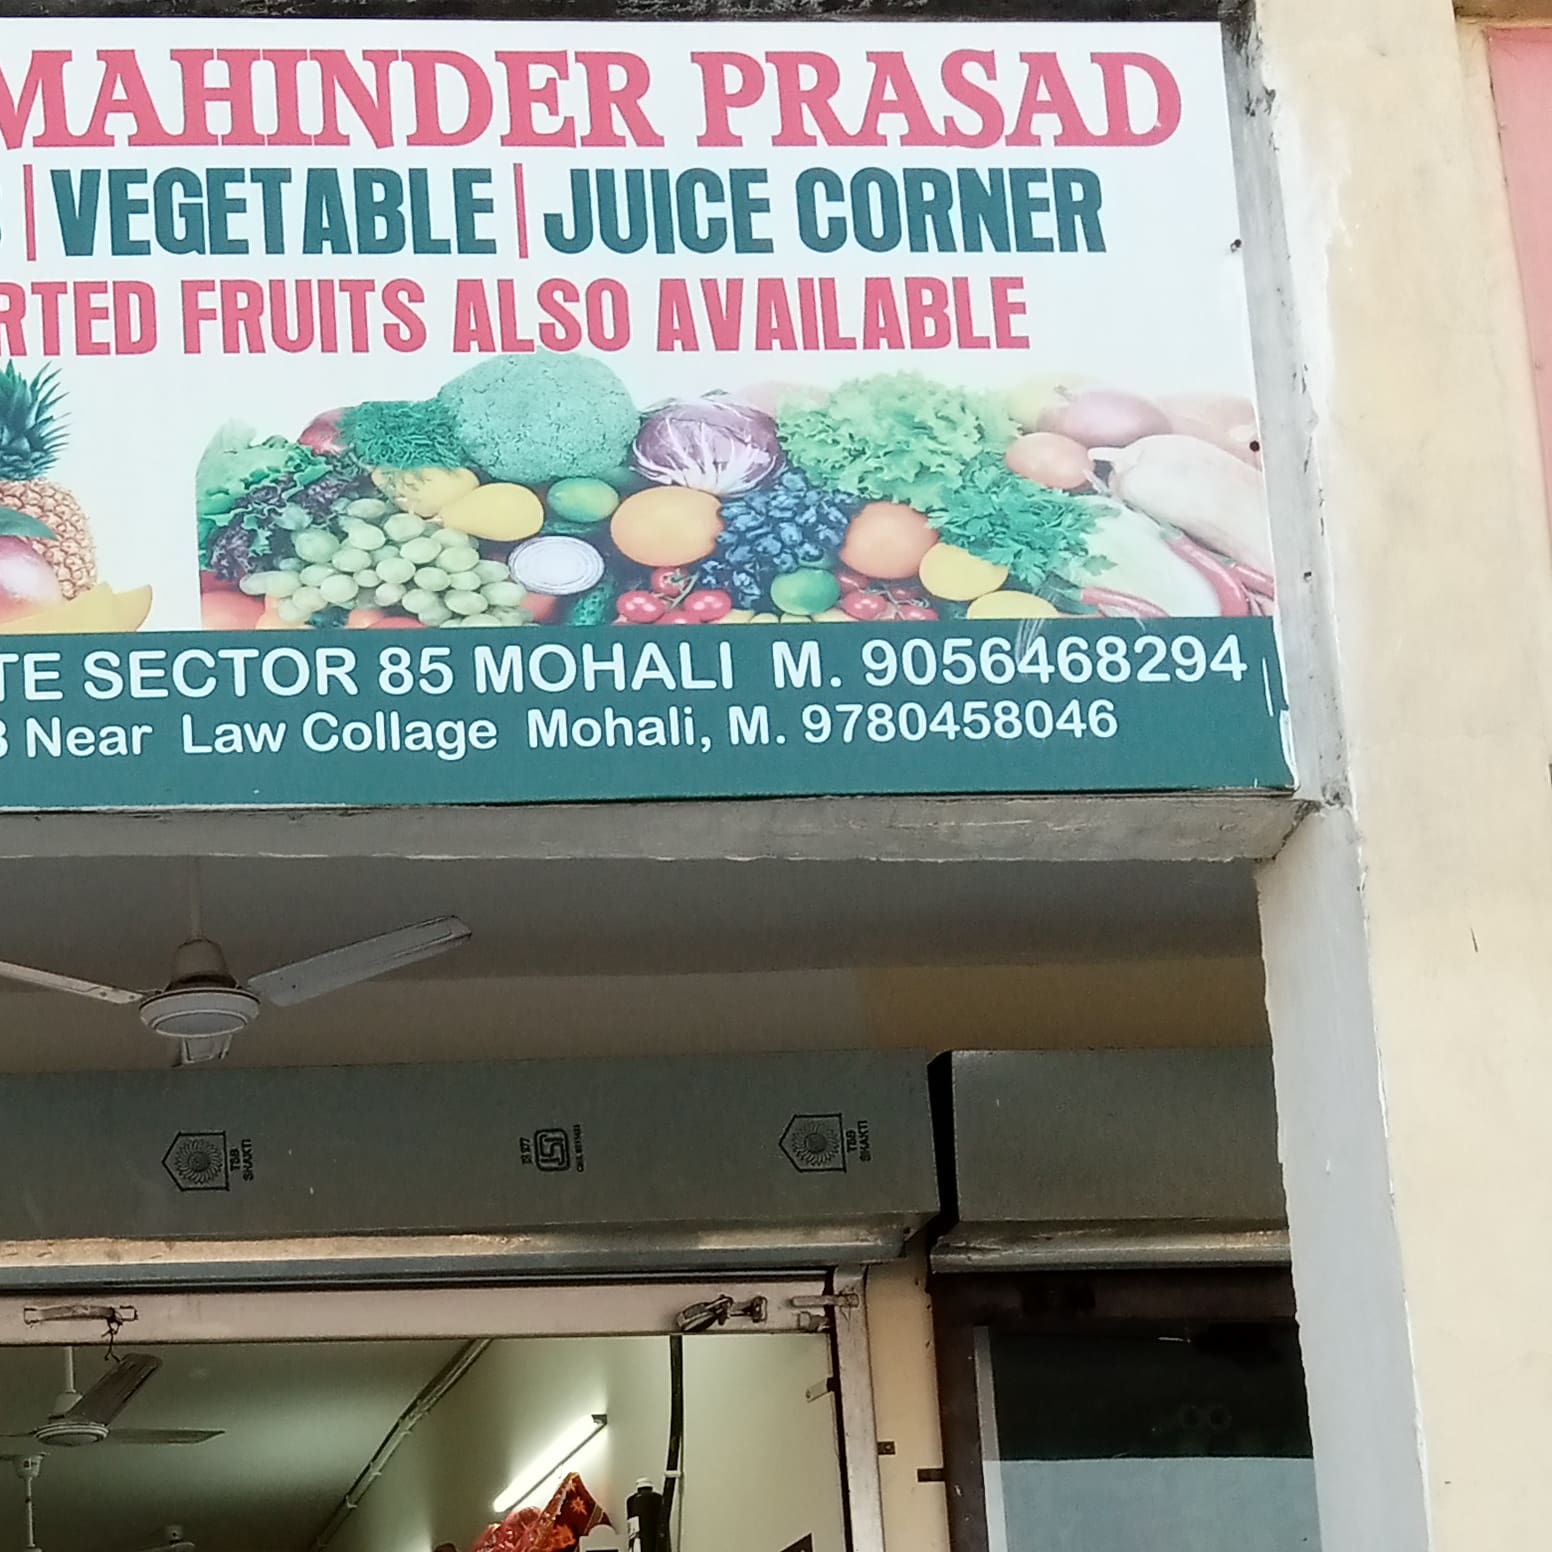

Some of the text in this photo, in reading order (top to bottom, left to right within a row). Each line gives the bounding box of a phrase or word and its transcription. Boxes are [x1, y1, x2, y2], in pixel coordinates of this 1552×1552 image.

[691, 51, 1181, 147] PRASAD
[52, 168, 496, 257] VEGETABLE
[545, 169, 771, 254] JUICE
[796, 168, 1106, 253] CORNER
[184, 280, 426, 355] FRUITS
[454, 279, 630, 353] ALSO
[657, 277, 1030, 351] AVAILABLE
[84, 647, 358, 700] SECTOR
[378, 647, 453, 695] 85
[474, 641, 733, 694] MOHALI
[772, 641, 842, 689] M.
[862, 634, 1248, 687] 9056468294
[26, 717, 153, 758] Near
[182, 714, 286, 754] Law
[302, 711, 497, 761] Collage
[527, 706, 711, 753] Mohali,
[728, 705, 789, 745] M.
[802, 699, 1118, 743] 9780458046
